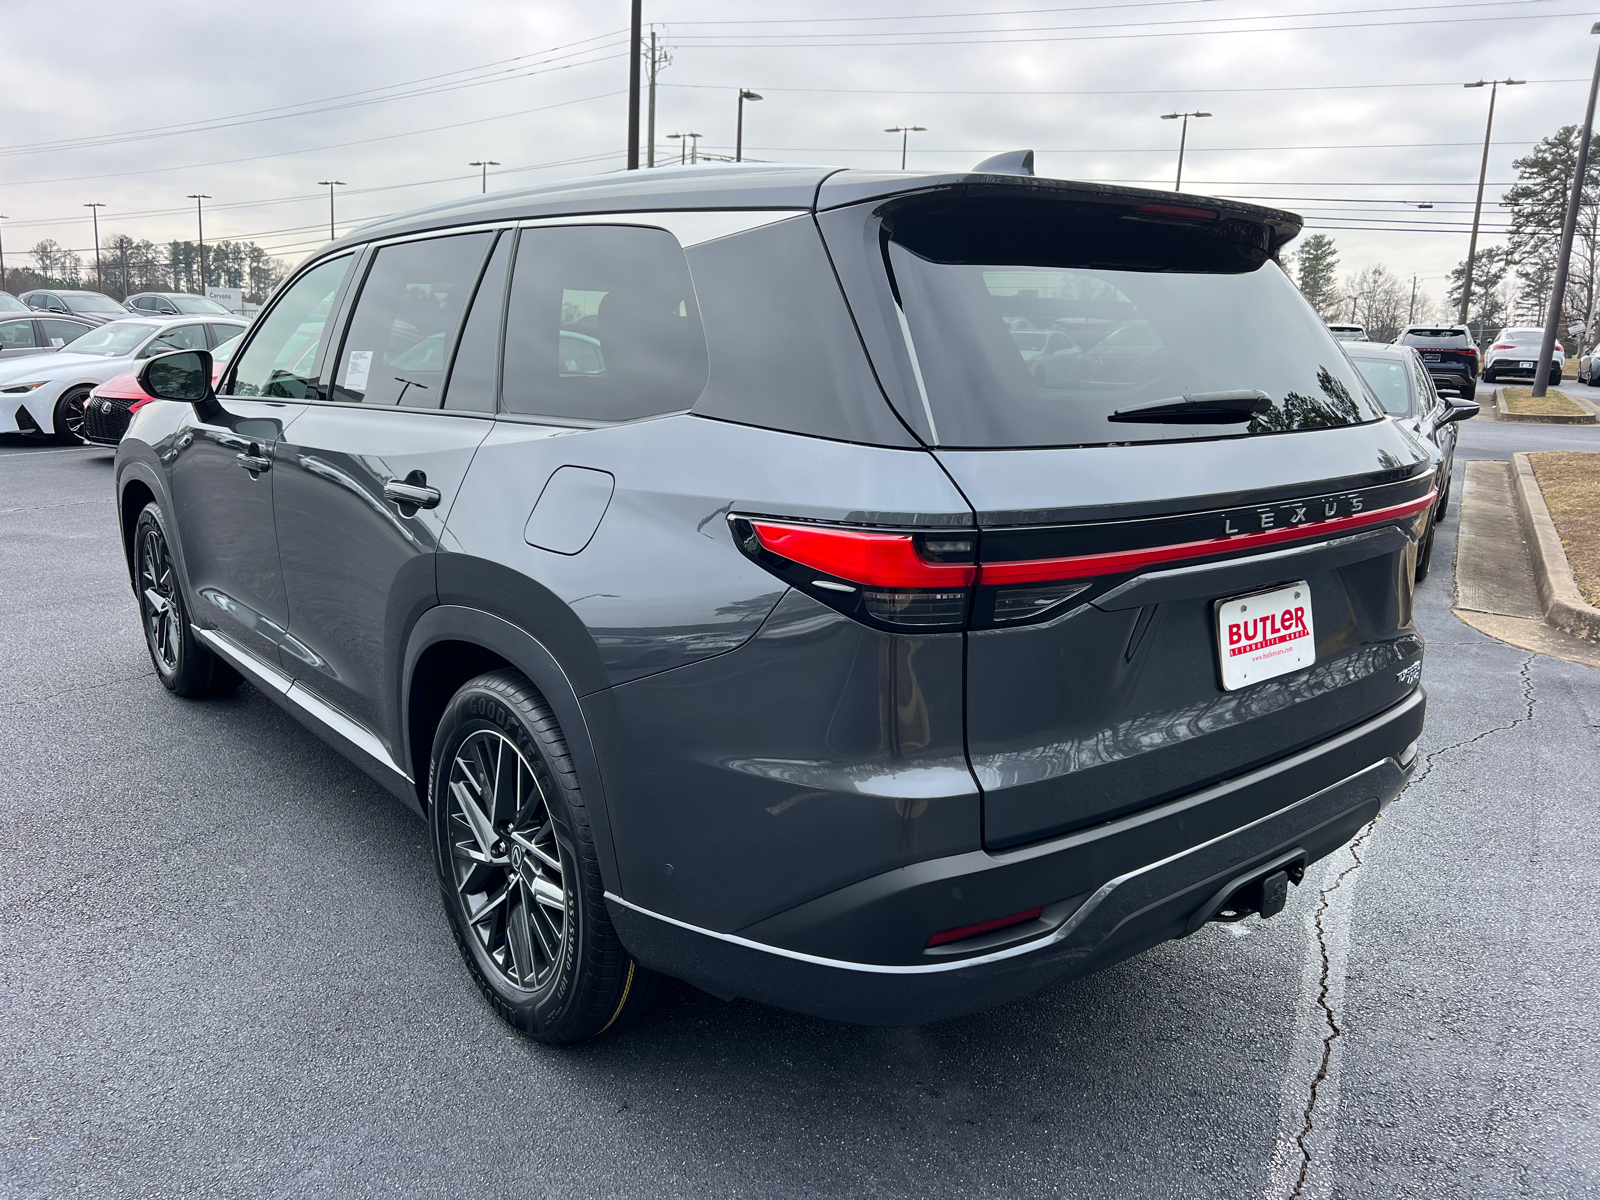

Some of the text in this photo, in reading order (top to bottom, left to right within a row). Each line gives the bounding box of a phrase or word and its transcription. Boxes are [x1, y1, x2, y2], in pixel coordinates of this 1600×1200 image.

[1225, 498, 1363, 534] LEXUS
[1286, 628, 1309, 641] GROUP
[1252, 646, 1293, 662] www.butlercars.com
[469, 696, 553, 798] GOODYEAR
